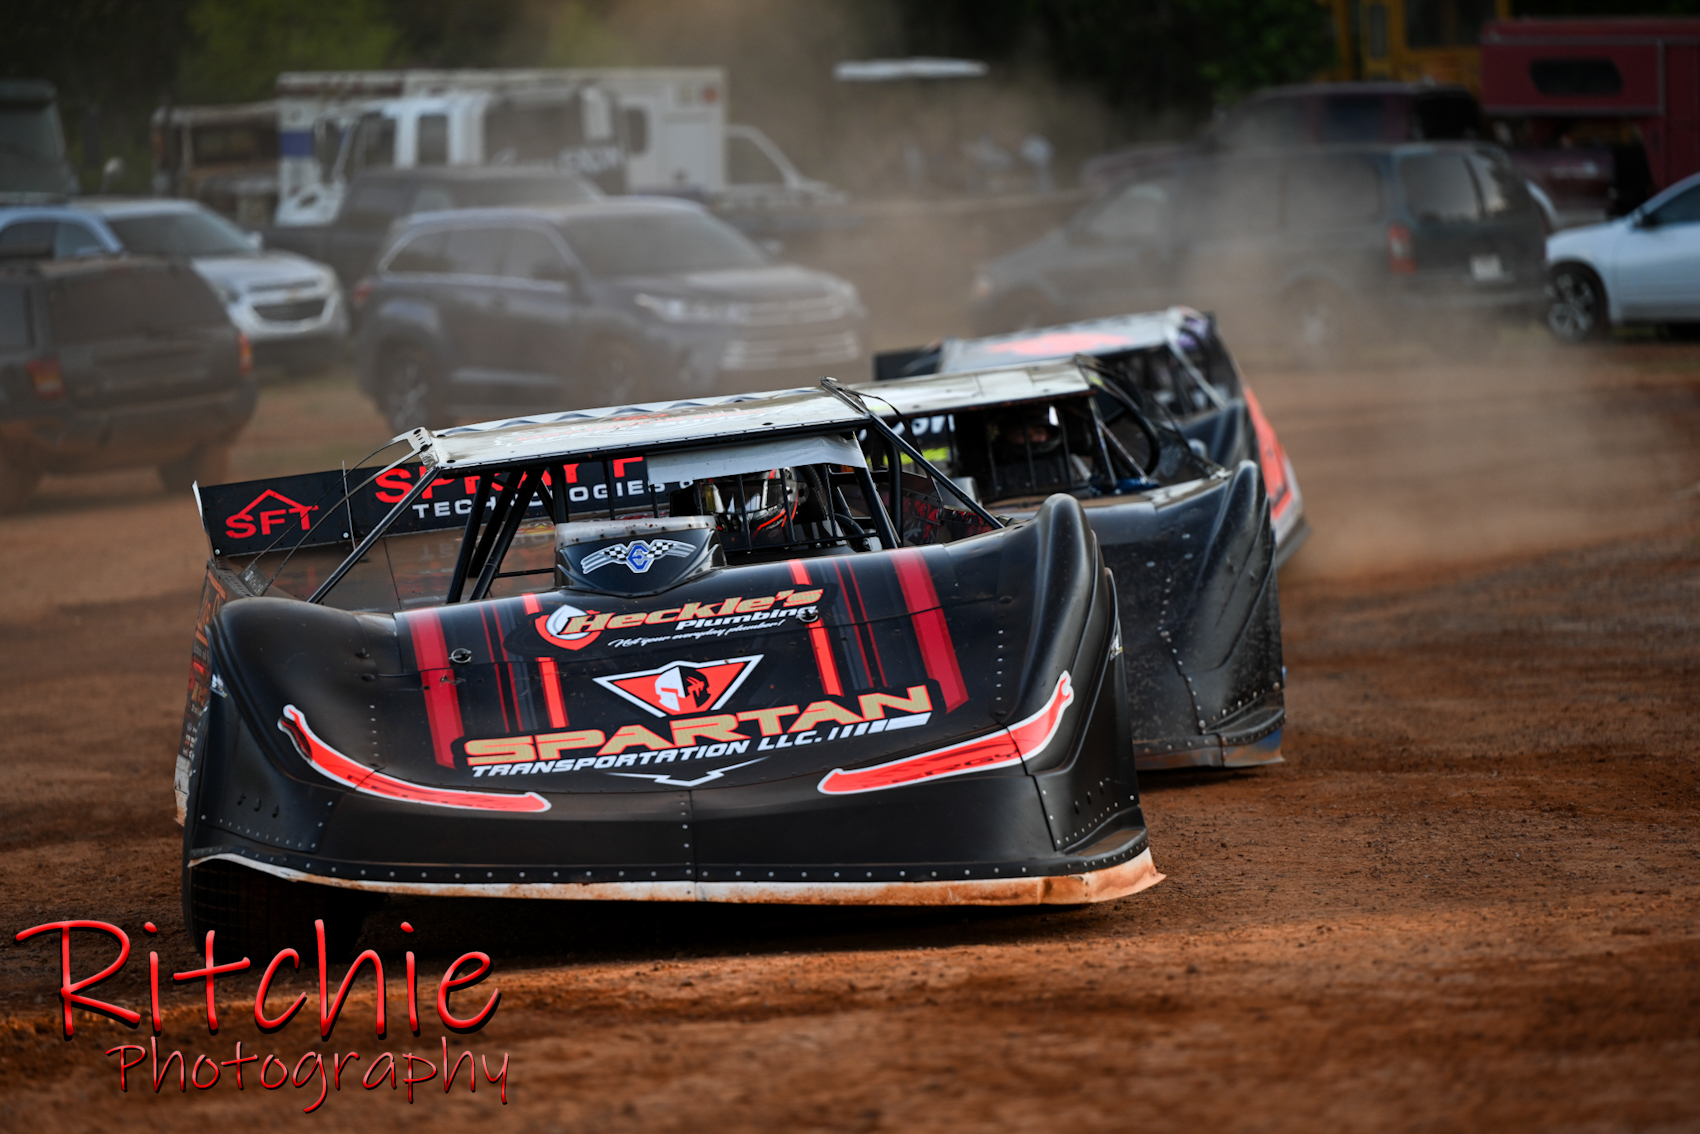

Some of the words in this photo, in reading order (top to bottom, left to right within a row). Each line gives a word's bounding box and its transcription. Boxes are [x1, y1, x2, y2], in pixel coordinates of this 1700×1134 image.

[225, 503, 319, 539] SFT
[556, 588, 823, 635] Heckle's
[607, 637, 643, 648] Not
[671, 628, 727, 640] everyday
[464, 685, 933, 767] SPARTAN
[472, 739, 750, 778] TRANSPORTATION
[757, 730, 822, 751] LLC.
